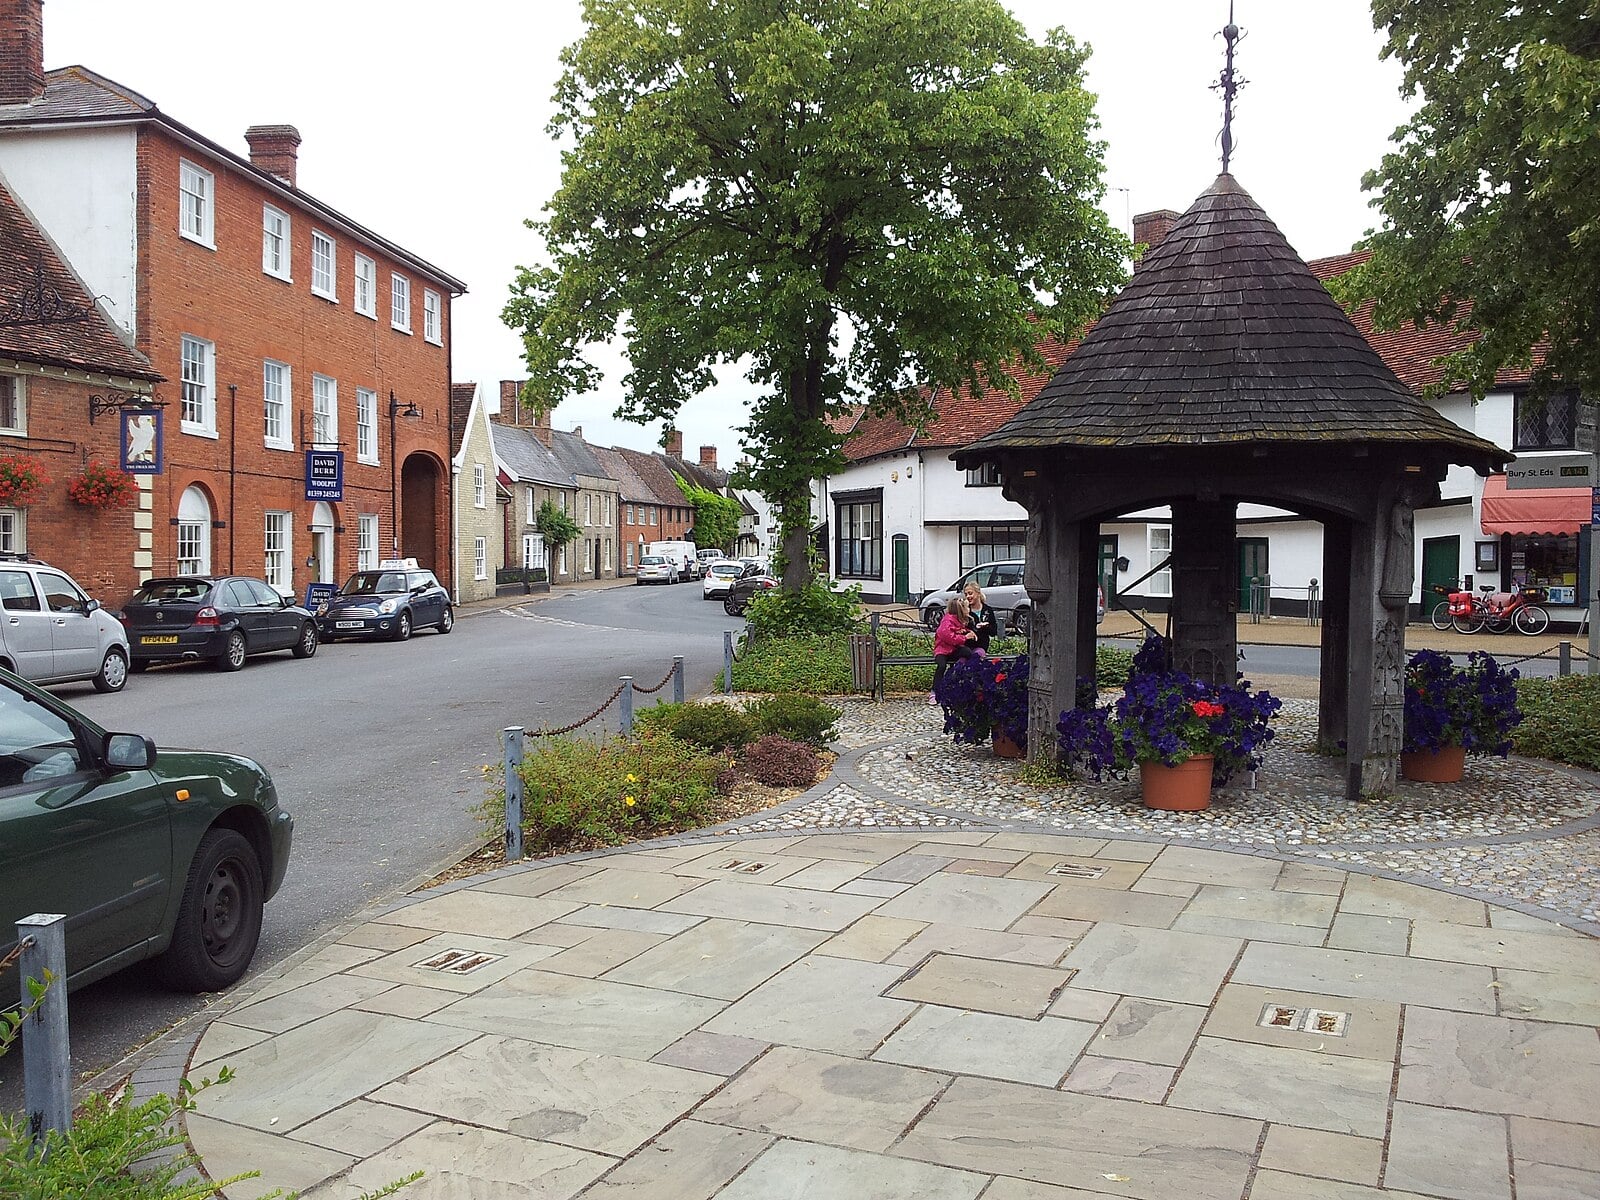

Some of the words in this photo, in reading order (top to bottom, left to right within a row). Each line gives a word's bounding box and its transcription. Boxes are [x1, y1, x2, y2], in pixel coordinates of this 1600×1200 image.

[314, 459, 335, 467] DAVID
[314, 467, 335, 475] BURR
[1508, 470, 1526, 478] Bury
